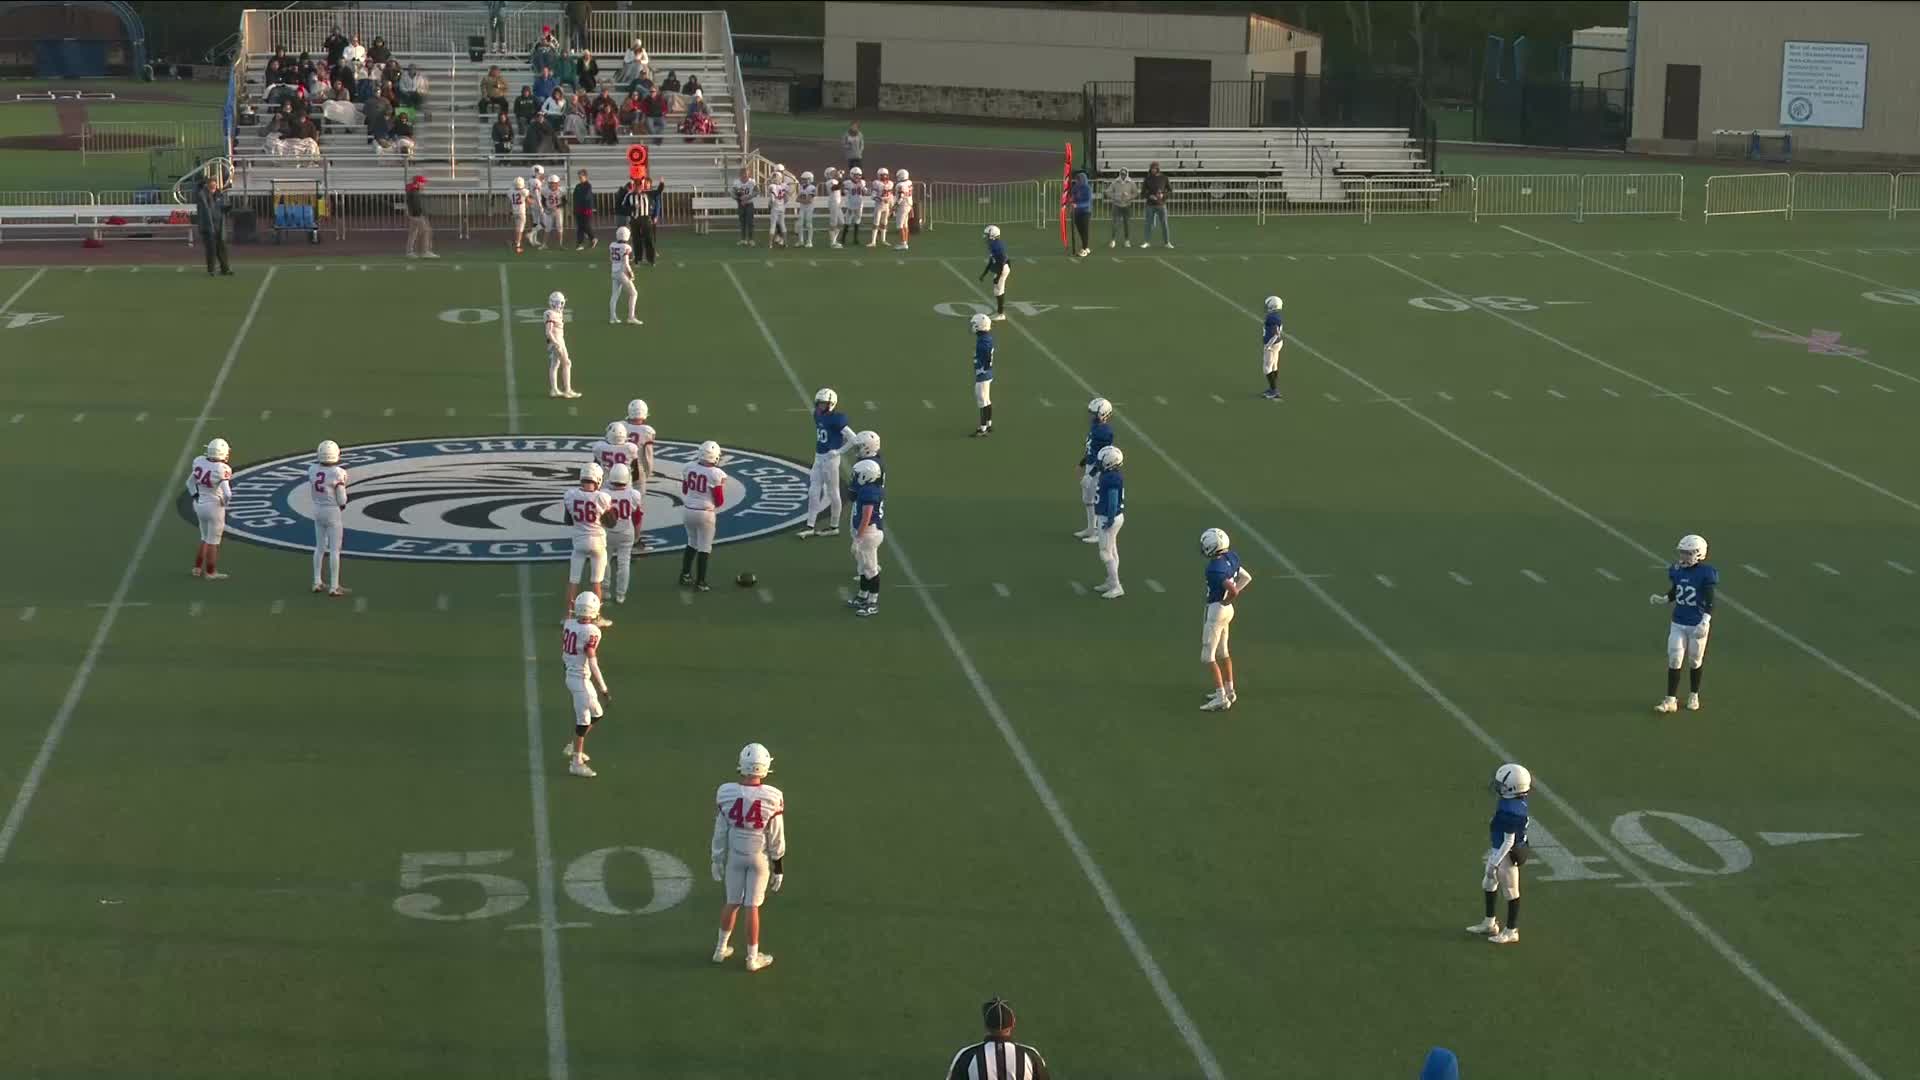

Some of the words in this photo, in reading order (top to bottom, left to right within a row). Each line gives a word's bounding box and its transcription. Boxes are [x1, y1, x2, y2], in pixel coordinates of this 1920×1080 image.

[226, 446, 408, 528] SOUTHWST
[733, 466, 809, 517] SCHOOL
[314, 471, 326, 493] 2
[687, 471, 708, 494] 60
[573, 500, 597, 523] 56
[379, 535, 669, 555] EAGLS
[1676, 584, 1697, 607] 22
[728, 797, 764, 829] 44
[392, 845, 694, 921] 50
